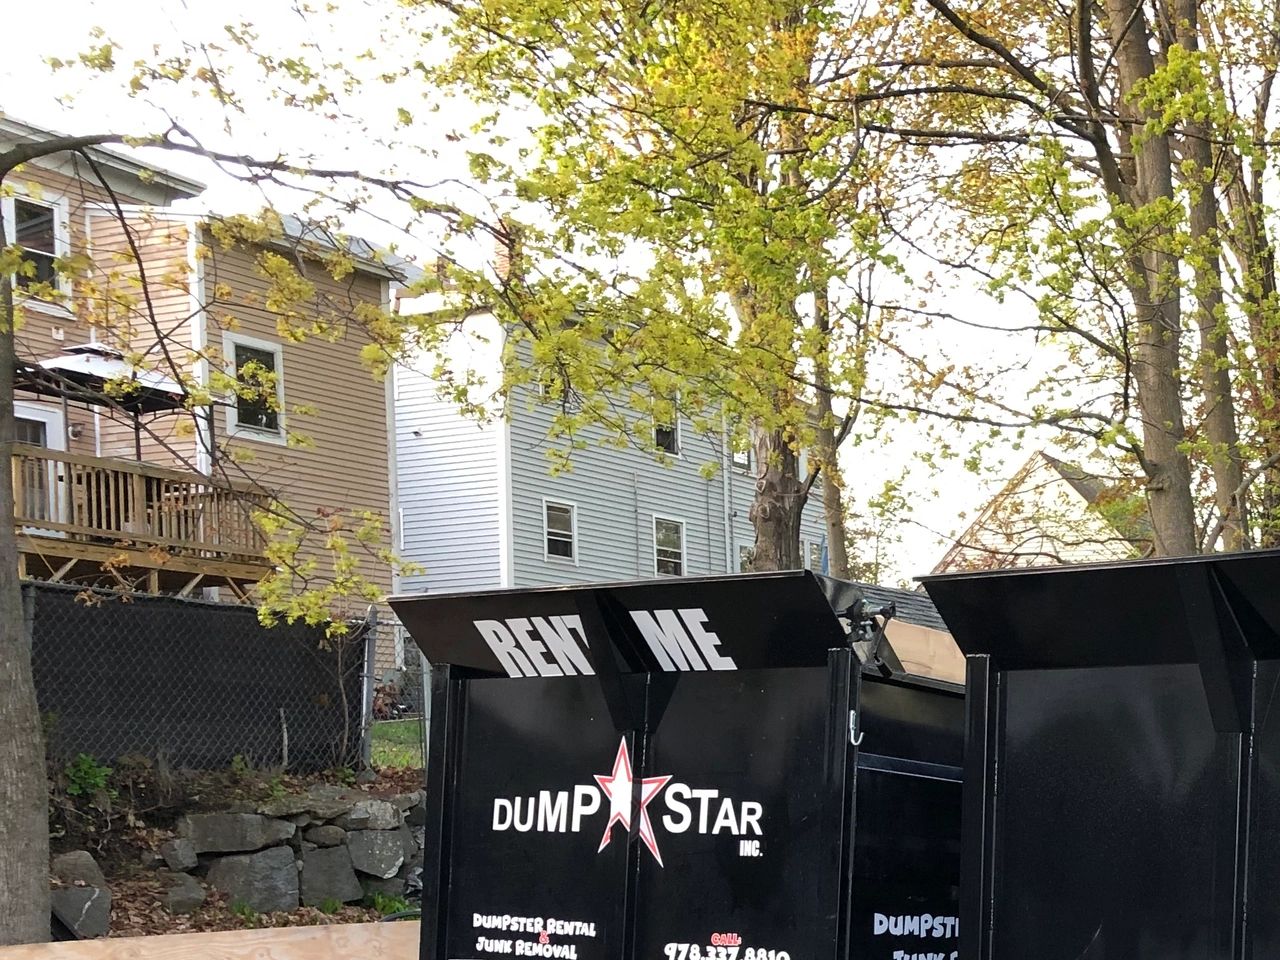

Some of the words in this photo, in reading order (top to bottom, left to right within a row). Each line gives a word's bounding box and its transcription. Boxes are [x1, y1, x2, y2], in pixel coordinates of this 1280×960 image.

[629, 608, 738, 672] ME
[492, 784, 600, 833] DUMP
[662, 783, 763, 836] STAR
[739, 839, 763, 857] INC.
[472, 912, 544, 934] DUMPSTER
[546, 918, 596, 938] RENTAL
[539, 929, 550, 945] &
[475, 936, 513, 954] JUNK
[515, 939, 578, 960] REMOVAL
[710, 932, 742, 946] CALL:
